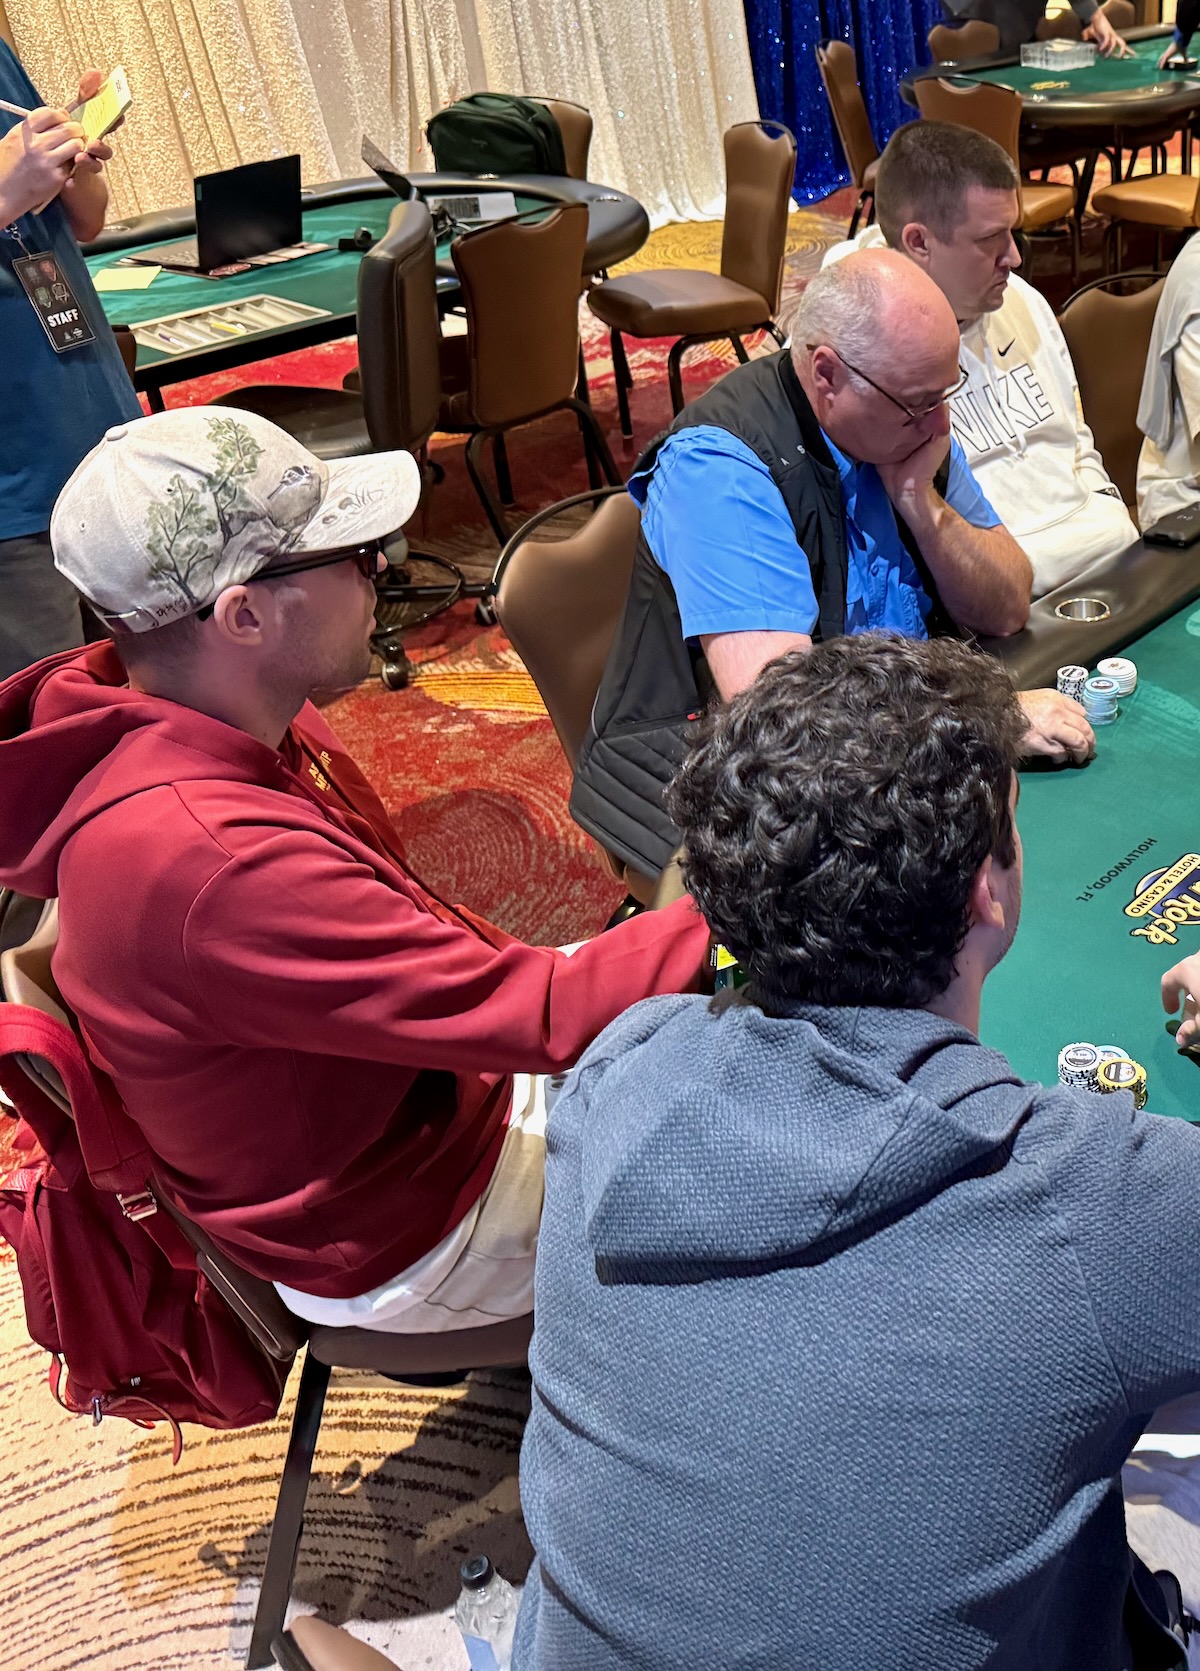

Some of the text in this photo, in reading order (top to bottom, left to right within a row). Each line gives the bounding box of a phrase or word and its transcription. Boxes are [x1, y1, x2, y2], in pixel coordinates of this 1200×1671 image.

[47, 308, 79, 328] STAFF
[948, 363, 1055, 453] NIKE
[1075, 837, 1158, 903] HOLLYWOOD, FL
[1171, 855, 1199, 877] HOTEL
[1130, 885, 1166, 915] CASINO
